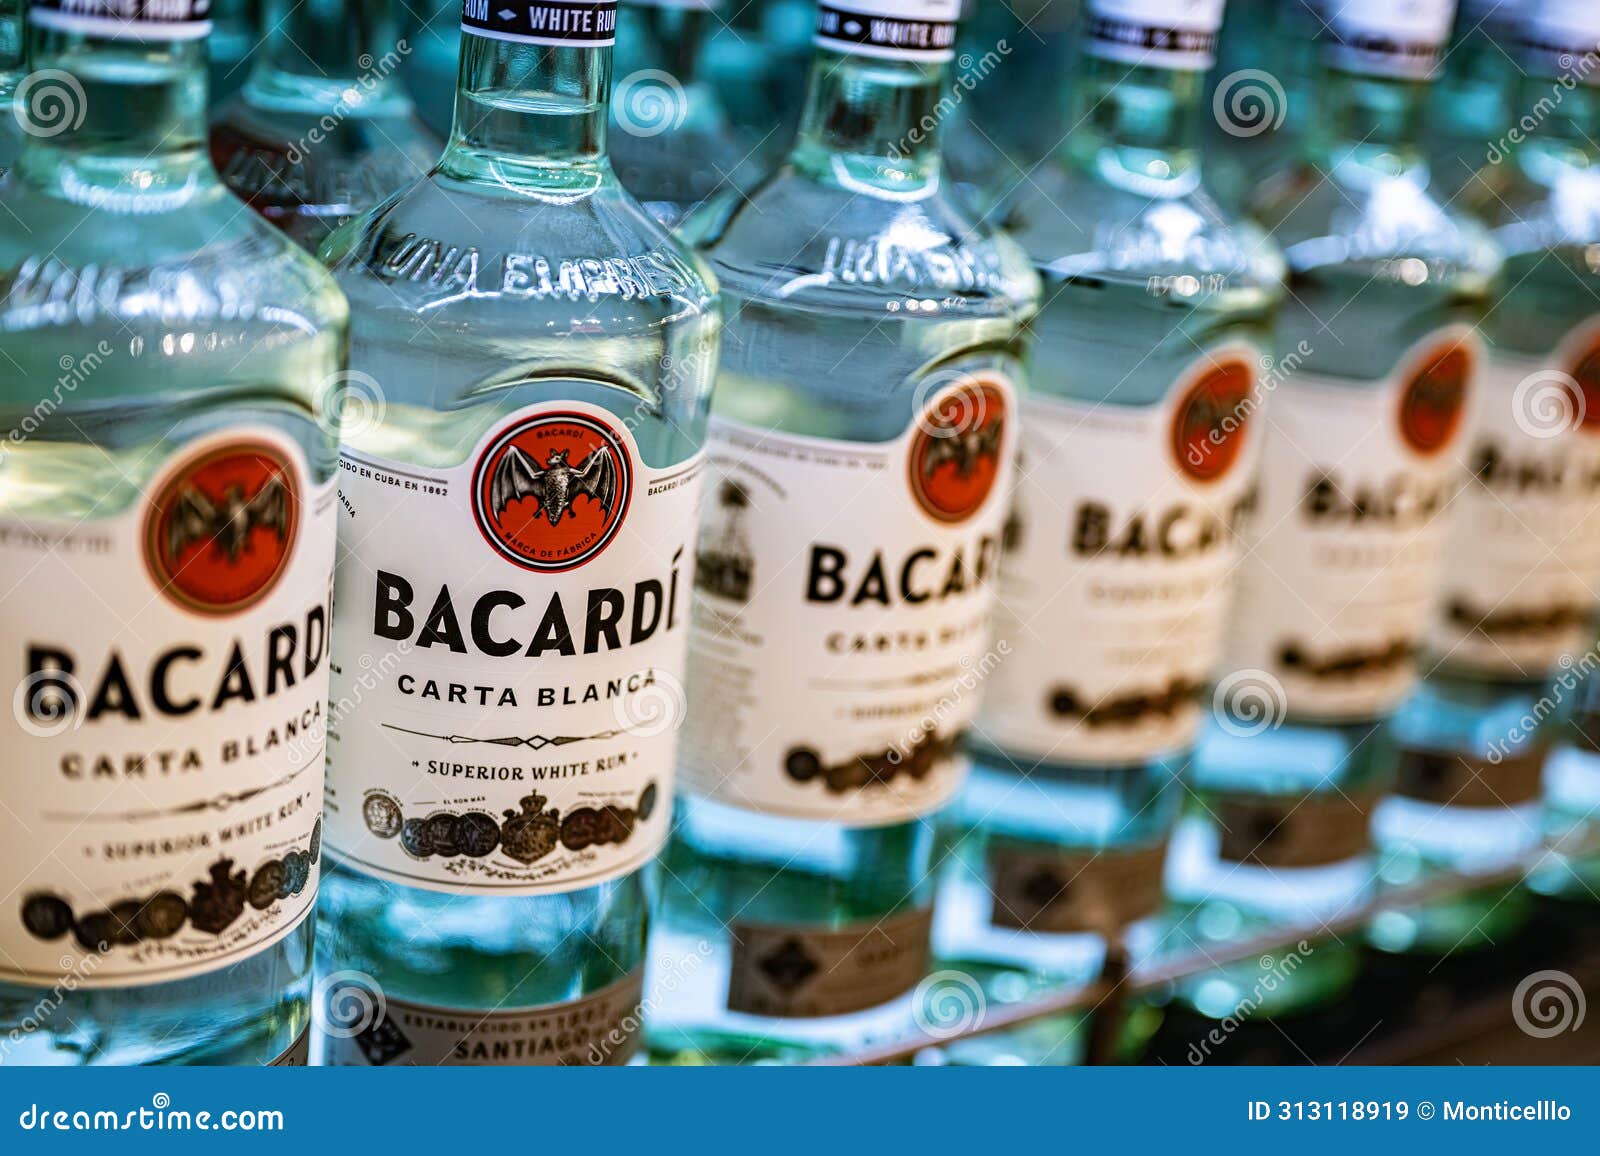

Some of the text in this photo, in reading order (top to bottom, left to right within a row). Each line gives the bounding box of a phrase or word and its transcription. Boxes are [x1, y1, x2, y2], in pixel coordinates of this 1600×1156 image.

[529, 6, 592, 33] WHITE
[360, 468, 371, 478] EN
[375, 473, 401, 487] CUBA
[405, 481, 418, 491] EN
[423, 486, 449, 496] 1862
[504, 532, 537, 555] MARCA
[373, 544, 685, 658] BACARDÍ
[397, 669, 657, 708] CARTA BLANCA
[60, 700, 321, 780] CARTA BLANCA
[427, 753, 628, 781] SUPERIOR WHITE RUM
